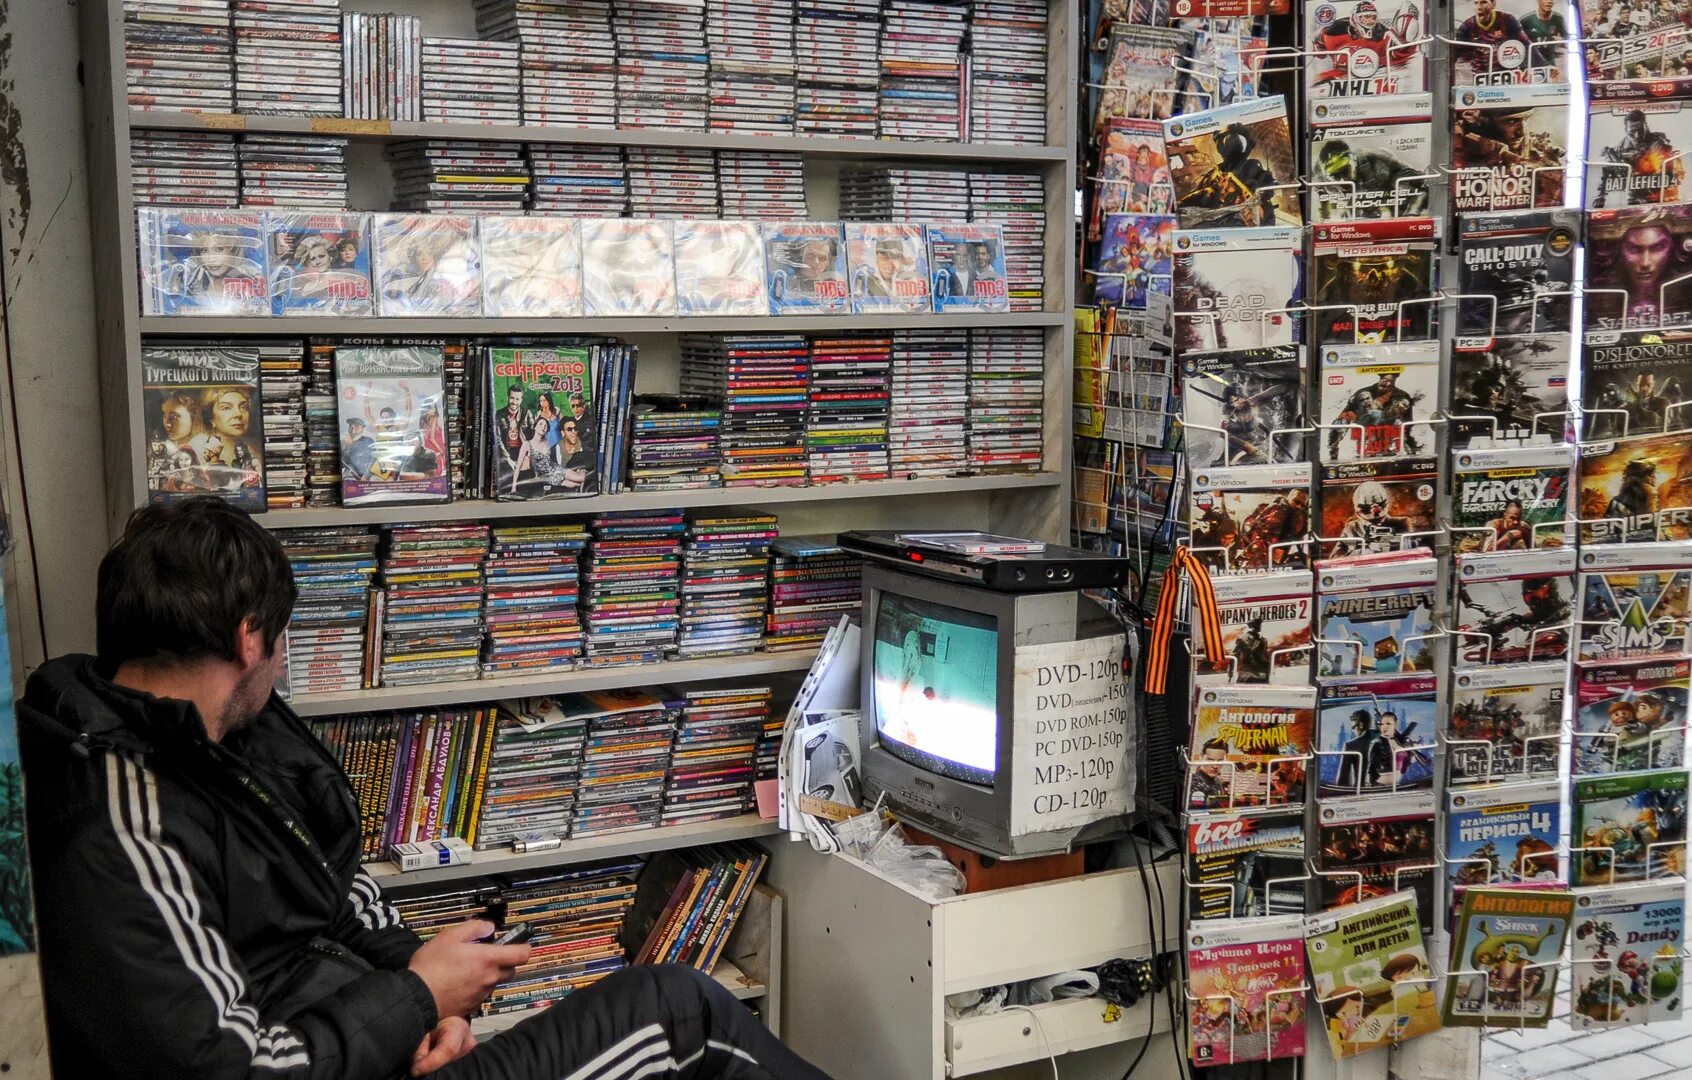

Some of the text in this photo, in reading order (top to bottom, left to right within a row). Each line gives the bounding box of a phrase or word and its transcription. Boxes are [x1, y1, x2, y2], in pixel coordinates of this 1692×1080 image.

[1503, 46, 1521, 56] EA
[1602, 39, 1648, 61] PES
[1355, 55, 1374, 65] EA
[1333, 80, 1374, 97] NHL
[1477, 90, 1505, 99] Games
[1184, 115, 1213, 127] Games
[1511, 165, 1533, 179] OF
[1455, 177, 1532, 198] HONOR
[1455, 195, 1532, 208] WARFGHTER
[1330, 225, 1356, 233] Games
[1342, 245, 1405, 256] НОВИНКА
[1464, 243, 1544, 265] CALL DUTY
[1470, 260, 1539, 272] GHOSTS
[1196, 295, 1266, 309] DEAD
[1190, 308, 1269, 325] SPACE
[342, 338, 385, 346] КОПЫ
[402, 338, 447, 346] ЮБКАХ
[1459, 339, 1473, 347] PC
[1588, 335, 1603, 344] PC
[178, 355, 220, 367] МИР
[146, 366, 209, 384] ТУРЕЦКОГО
[550, 376, 584, 392] 2013
[1581, 445, 1595, 454] PC
[1421, 462, 1435, 470] DVD
[1591, 510, 1692, 537] SNIPER
[1259, 599, 1308, 621] HEROES 2
[1325, 590, 1435, 615] MINECRAFT
[1217, 708, 1297, 724] Антология
[1036, 718, 1067, 734] DVD
[1213, 724, 1289, 749] SPIDER-MAN
[1035, 740, 1056, 757] PC
[369, 740, 388, 814] ВЕЛИКОЛЕПНЫЙ
[378, 738, 397, 813] ВЕЛИКОЛЕПНЫЙ
[425, 731, 452, 842] ЛЕКСАНДР АБДУЛОВ
[1459, 811, 1551, 842] ПЕРИОД 4
[1472, 894, 1571, 916] АНТОЛОГИЯ
[1643, 907, 1682, 919] 13000
[1341, 905, 1411, 936] АНГЛИЙСКИЙ
[1352, 930, 1411, 956] ДЛЯ ДЕТЕЙ
[1626, 927, 1681, 946] Dendy
